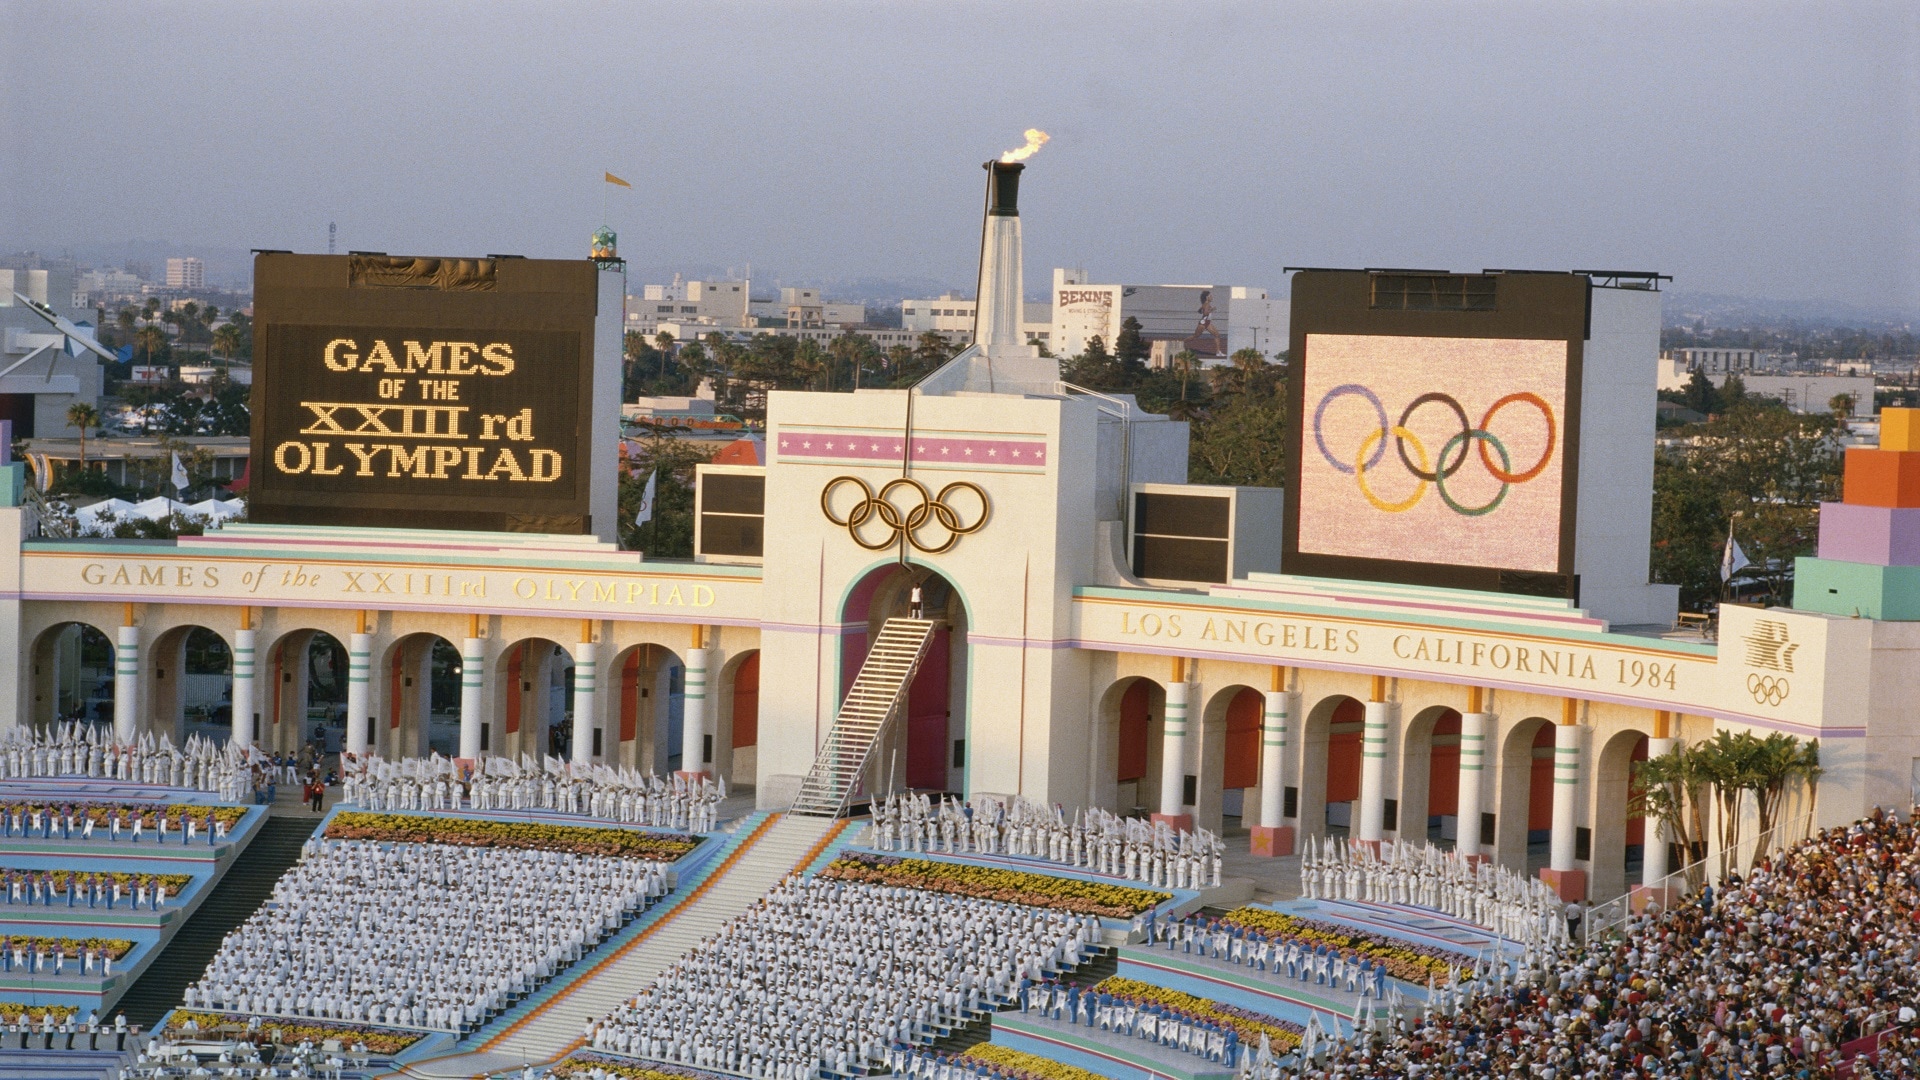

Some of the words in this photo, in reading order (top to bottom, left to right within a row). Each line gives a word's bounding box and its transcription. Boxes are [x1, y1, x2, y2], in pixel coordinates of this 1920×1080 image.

[1059, 290, 1113, 307] BEKINS
[324, 339, 515, 375] GAMES
[379, 379, 405, 399] OF
[419, 380, 459, 400] THE
[300, 401, 469, 439] XXIII
[479, 408, 535, 441] rd
[274, 441, 562, 482] OLYMPIAD
[81, 563, 220, 588] GAMES
[242, 564, 271, 593] of
[281, 565, 321, 587] the
[341, 570, 487, 597] XXIIIrd
[513, 577, 716, 608] OLYMPIAD
[1120, 611, 1182, 637] LOS
[1199, 617, 1360, 654] ANGELES
[1393, 634, 1599, 681] CALIFORNIA
[1617, 658, 1678, 691] 1984
